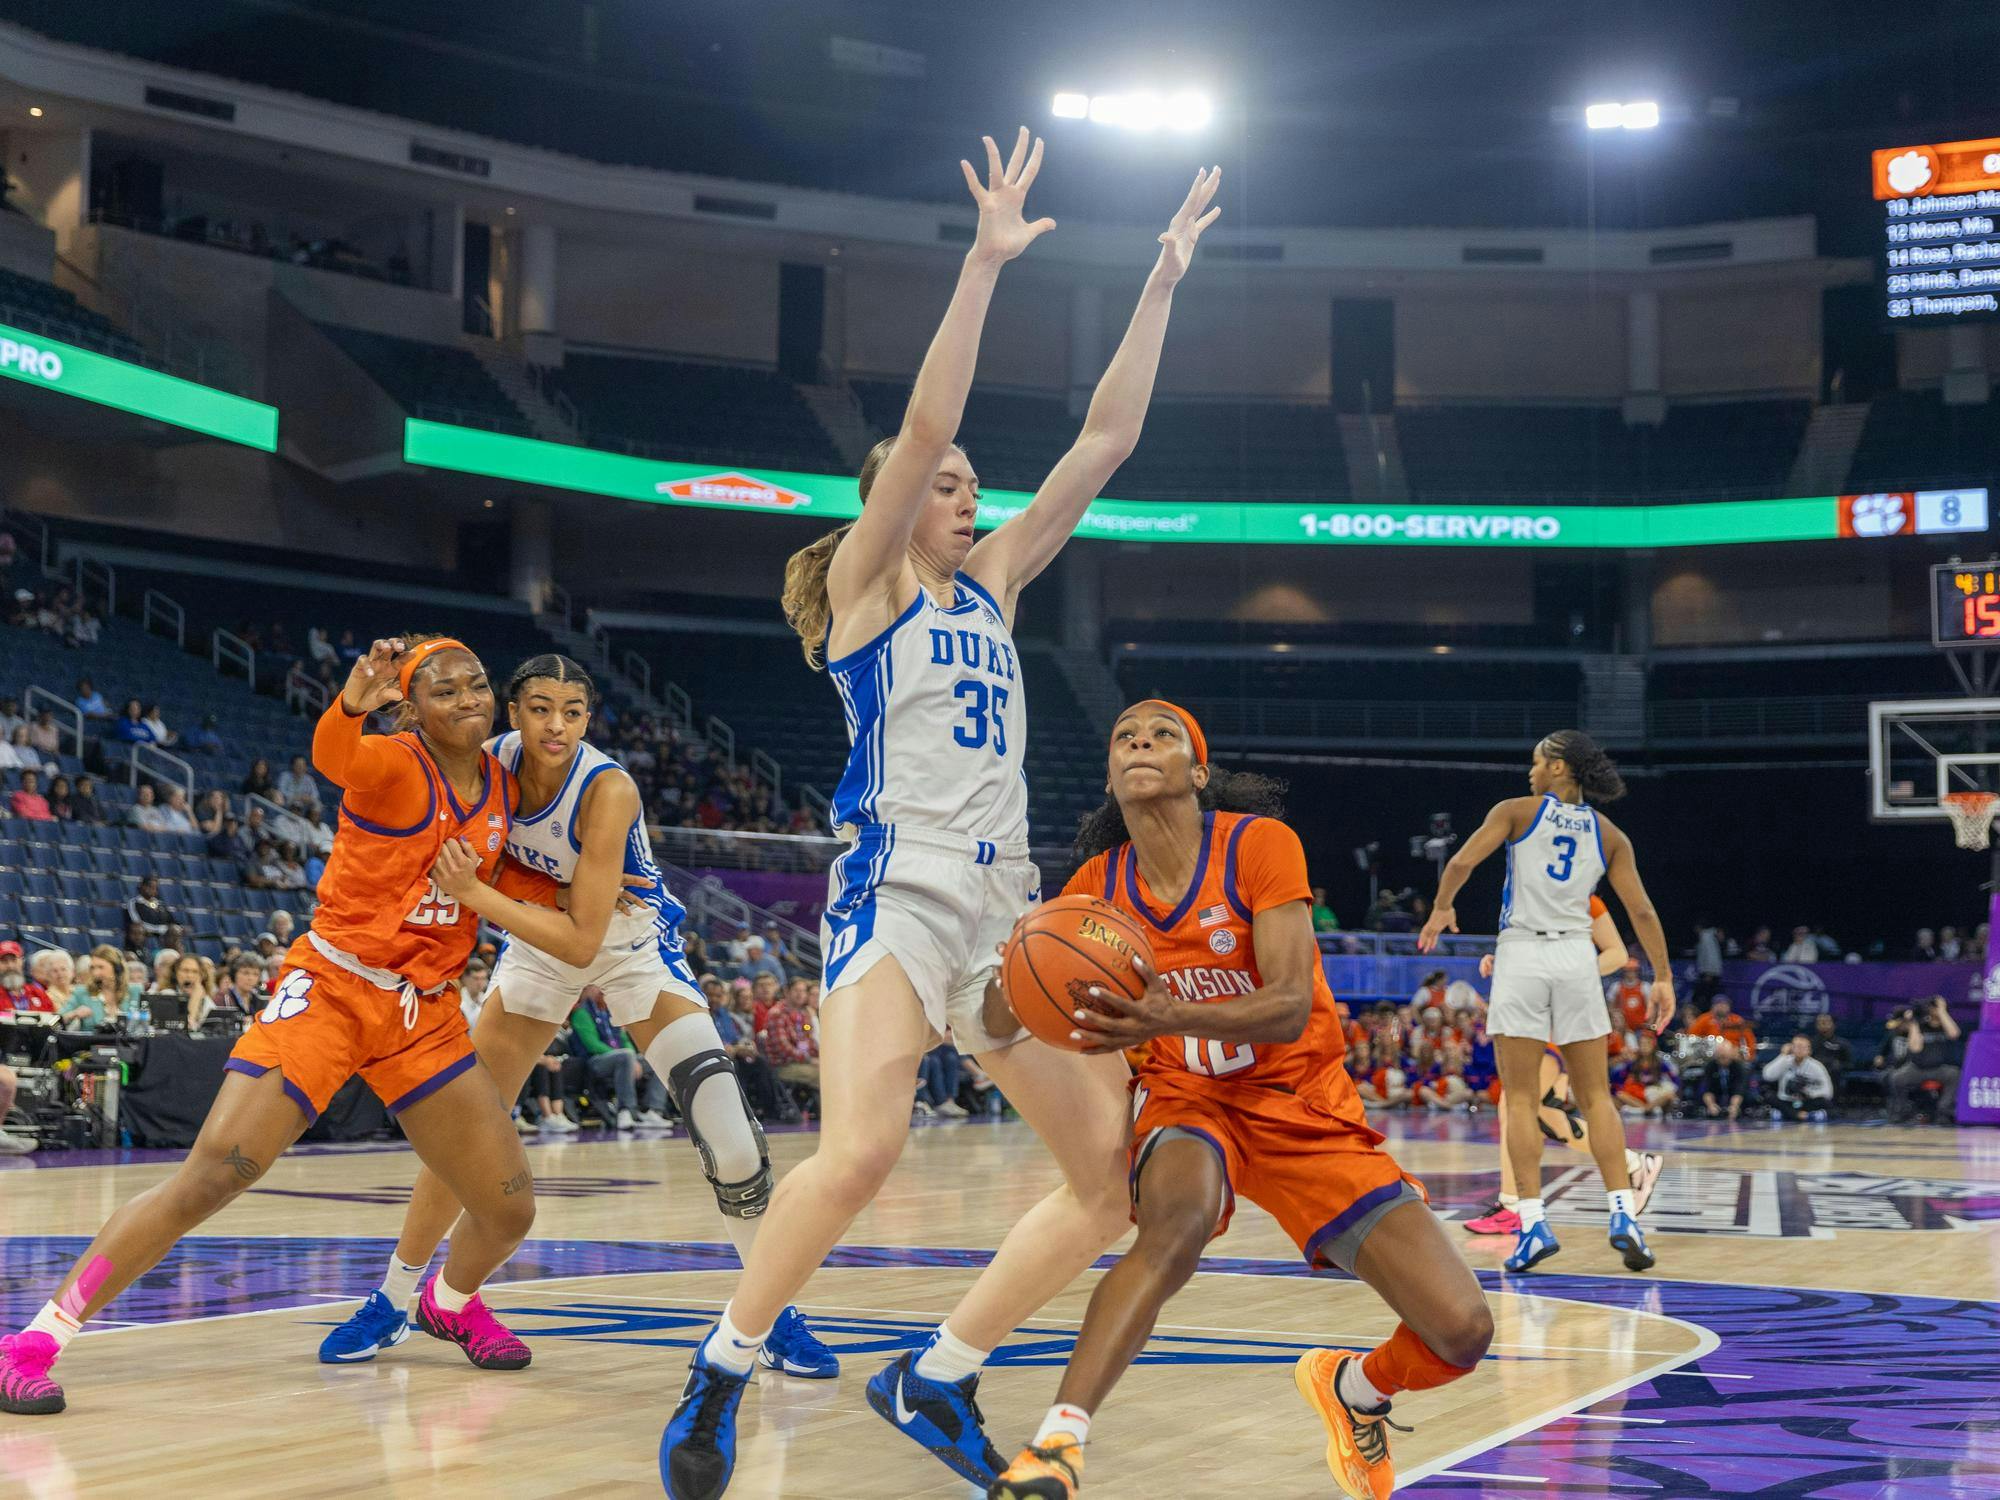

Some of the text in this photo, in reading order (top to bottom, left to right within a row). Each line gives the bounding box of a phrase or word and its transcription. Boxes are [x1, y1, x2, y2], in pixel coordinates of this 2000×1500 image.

[1886, 224, 1909, 242] 12
[1962, 216, 1994, 235] Mia
[1887, 273, 1911, 293] 25
[0, 337, 63, 381] PRO
[1299, 512, 1561, 540] 1-800-SERVPRO
[1941, 496, 1961, 526] 8
[1955, 571, 2000, 595] 4:1
[929, 628, 1015, 682] DUKE
[953, 679, 1009, 757] 35
[975, 840, 996, 866] D
[1546, 835, 1577, 882] 3
[404, 876, 460, 926] 25
